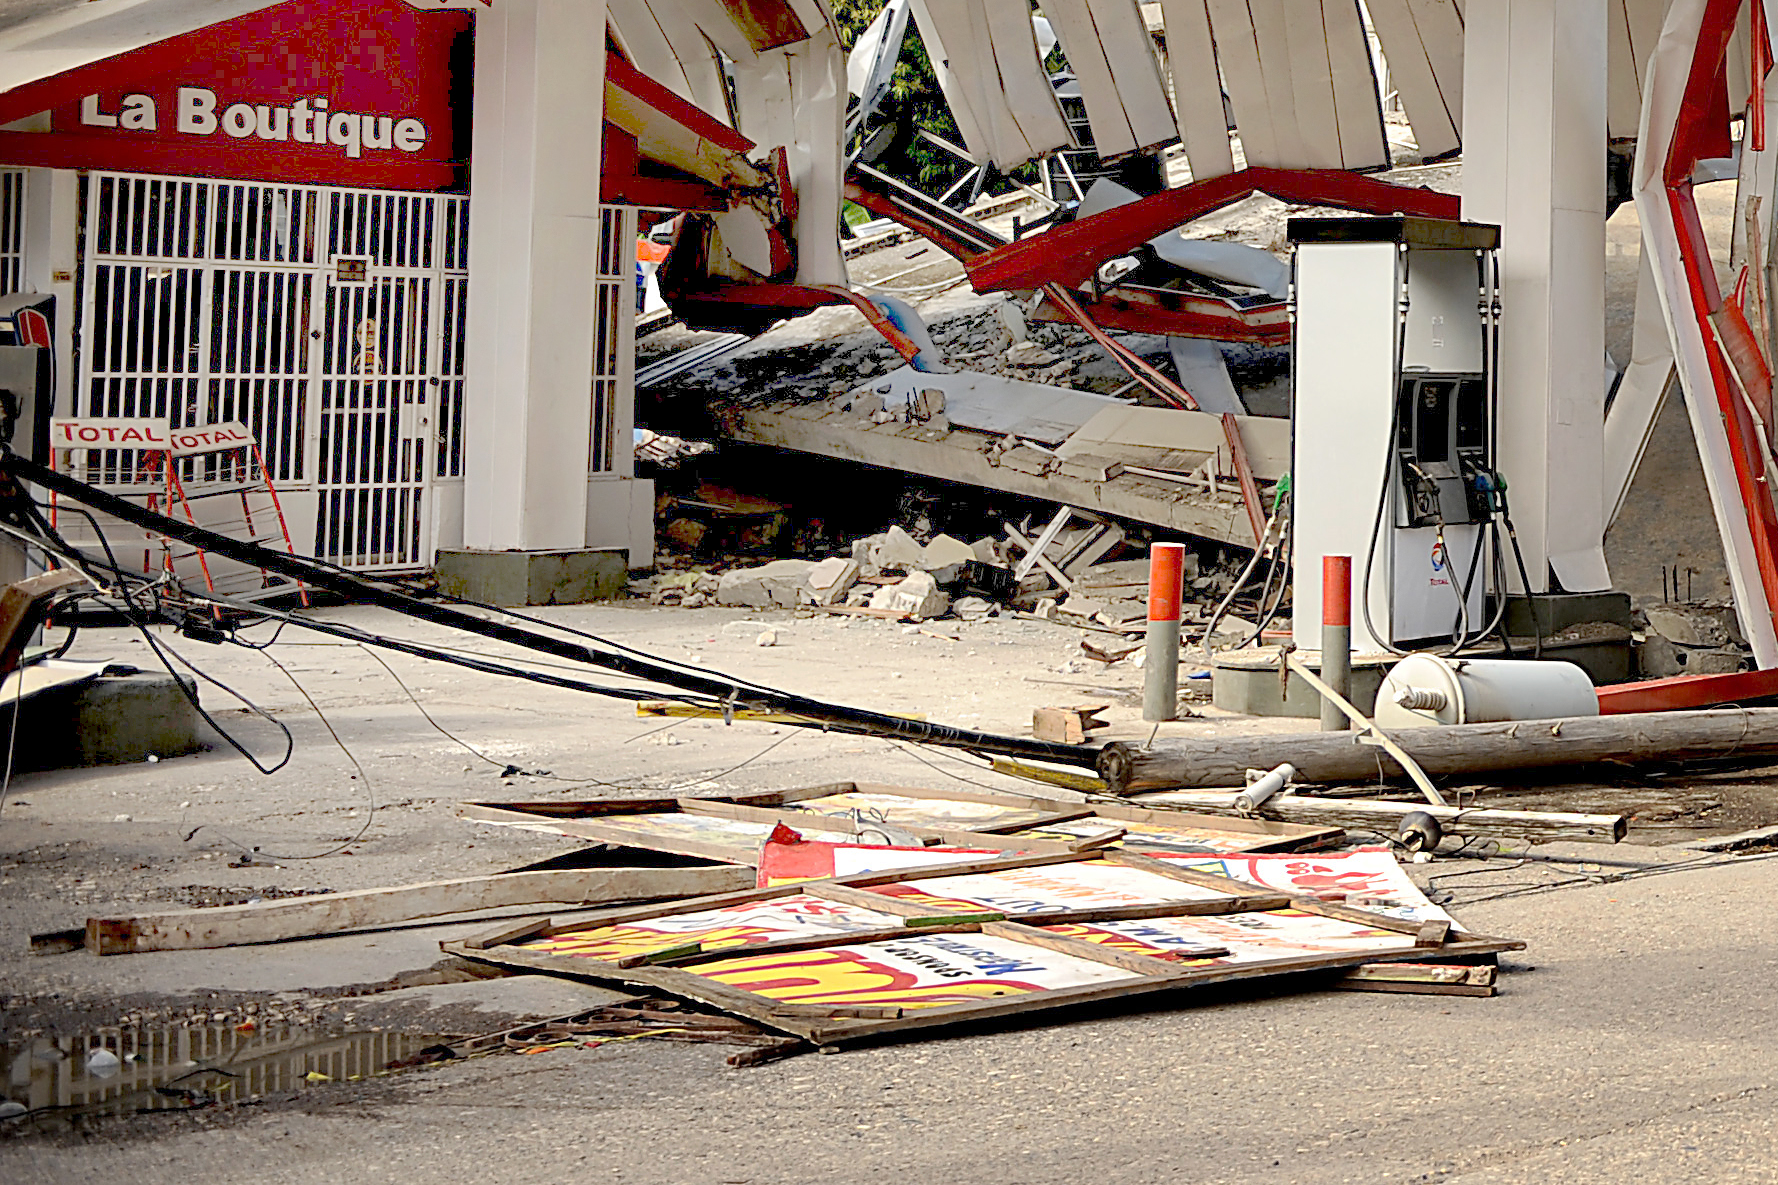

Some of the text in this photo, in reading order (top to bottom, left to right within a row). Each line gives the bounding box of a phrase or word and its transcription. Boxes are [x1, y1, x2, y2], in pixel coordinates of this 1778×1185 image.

[81, 85, 426, 158] La Boutique
[56, 423, 164, 442] TOTAL
[170, 429, 248, 450] TOTAL
